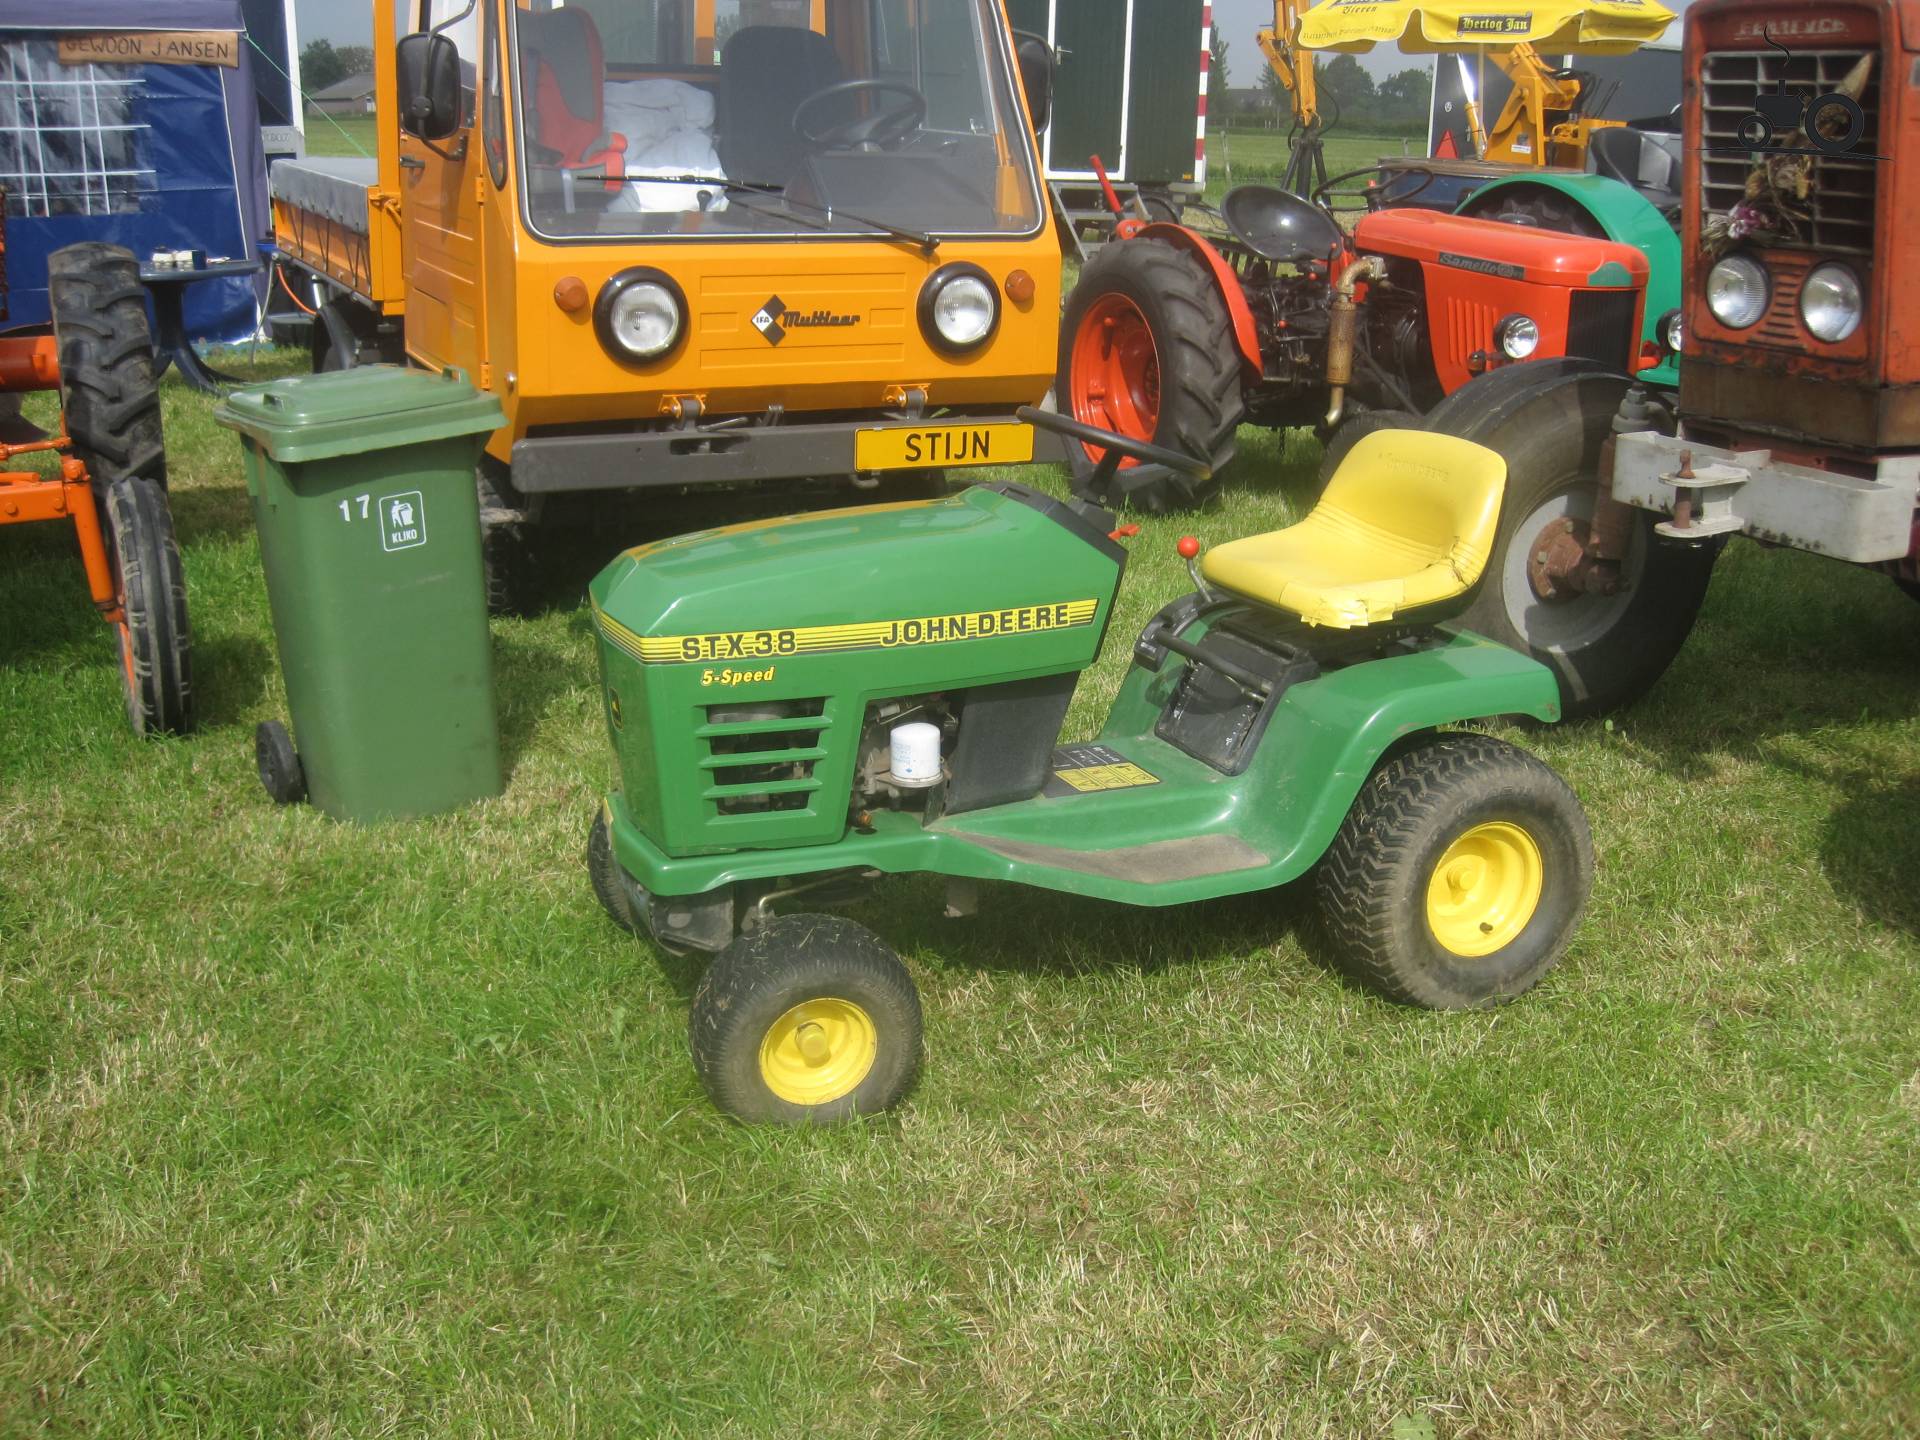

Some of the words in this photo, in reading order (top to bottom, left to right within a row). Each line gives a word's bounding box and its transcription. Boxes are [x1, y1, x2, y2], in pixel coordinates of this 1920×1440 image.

[1462, 17, 1503, 31] Hertog
[1505, 17, 1528, 31] Jan
[65, 37, 142, 55] GEWOON
[755, 315, 771, 324] IFA
[904, 430, 990, 462] STIJN
[391, 529, 418, 543] KLIKO
[881, 616, 967, 645] JOHN
[978, 604, 1070, 633] DEERE
[681, 633, 744, 660] STX
[754, 630, 797, 655] 38
[700, 665, 776, 688] 5-Speed
